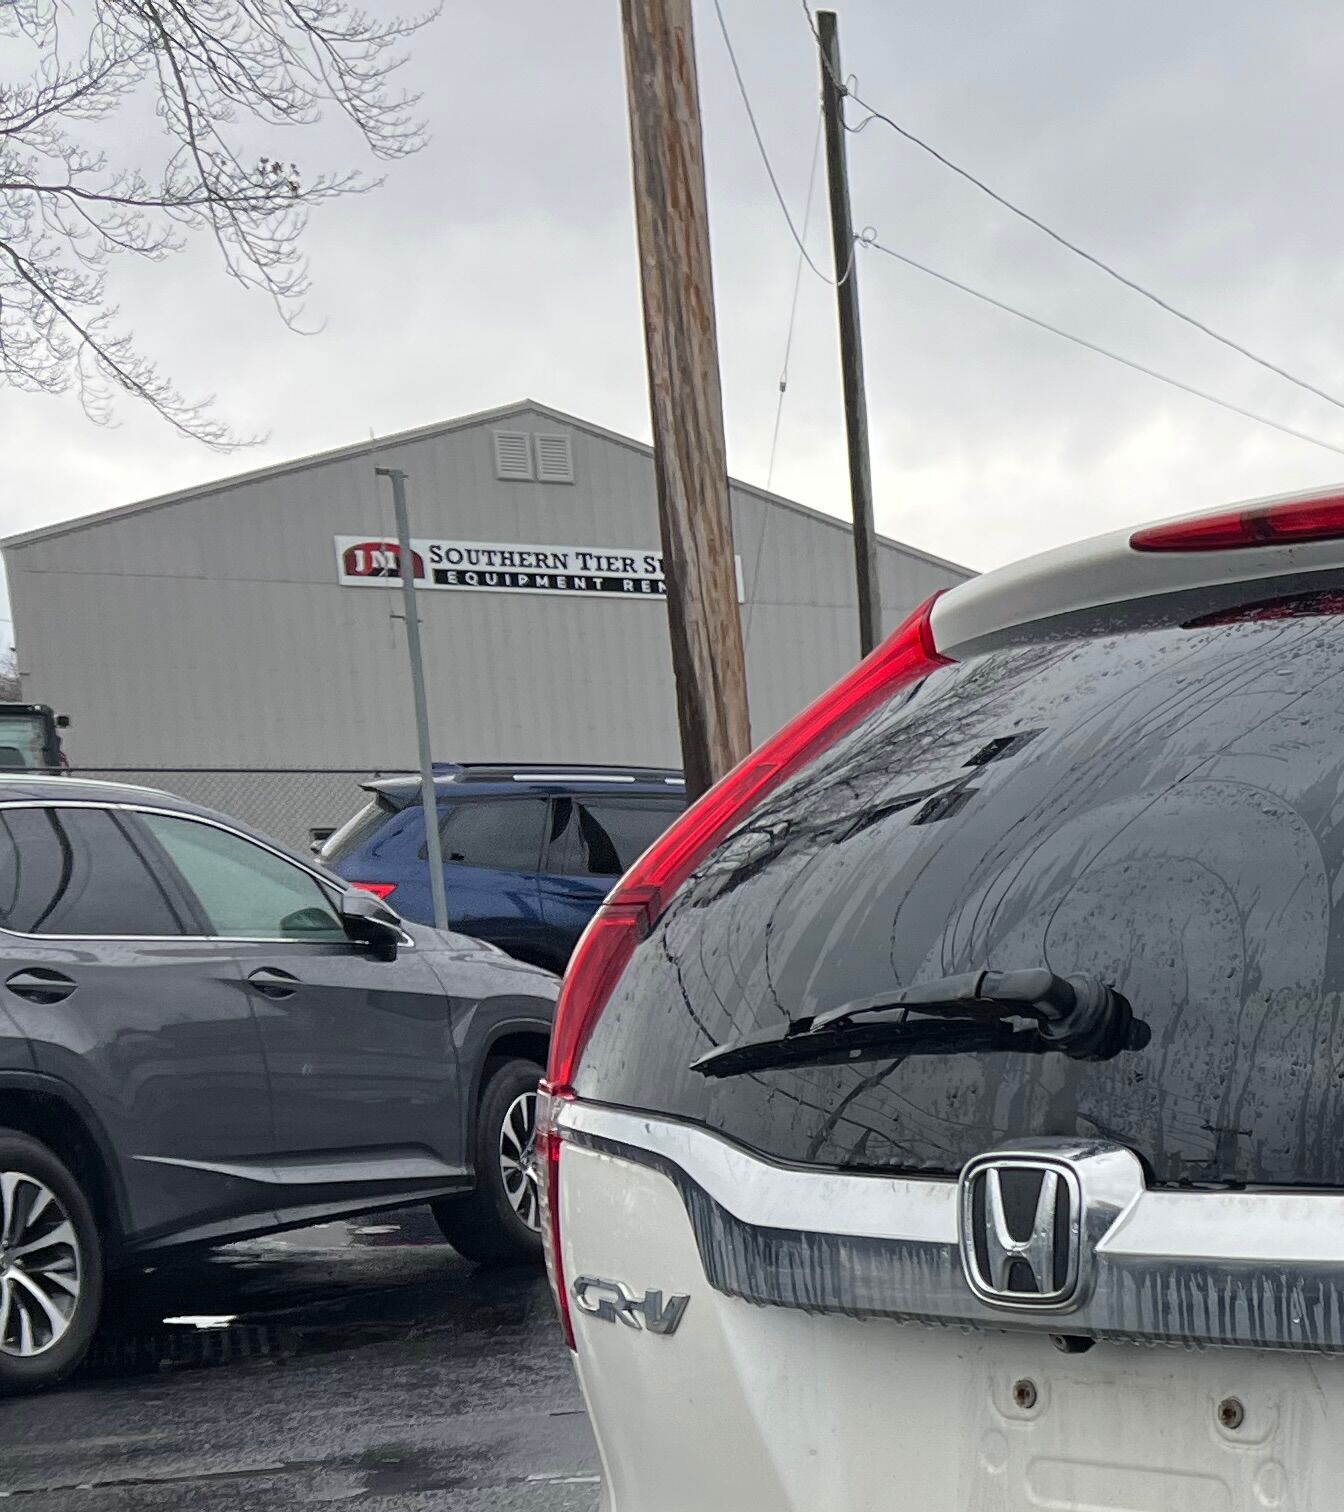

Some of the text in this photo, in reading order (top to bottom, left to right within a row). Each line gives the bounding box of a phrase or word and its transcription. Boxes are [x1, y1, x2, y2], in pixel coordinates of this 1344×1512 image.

[429, 544, 569, 570] SOUTHERN
[575, 552, 637, 573] TIER
[447, 571, 603, 590] EQUIPMENT
